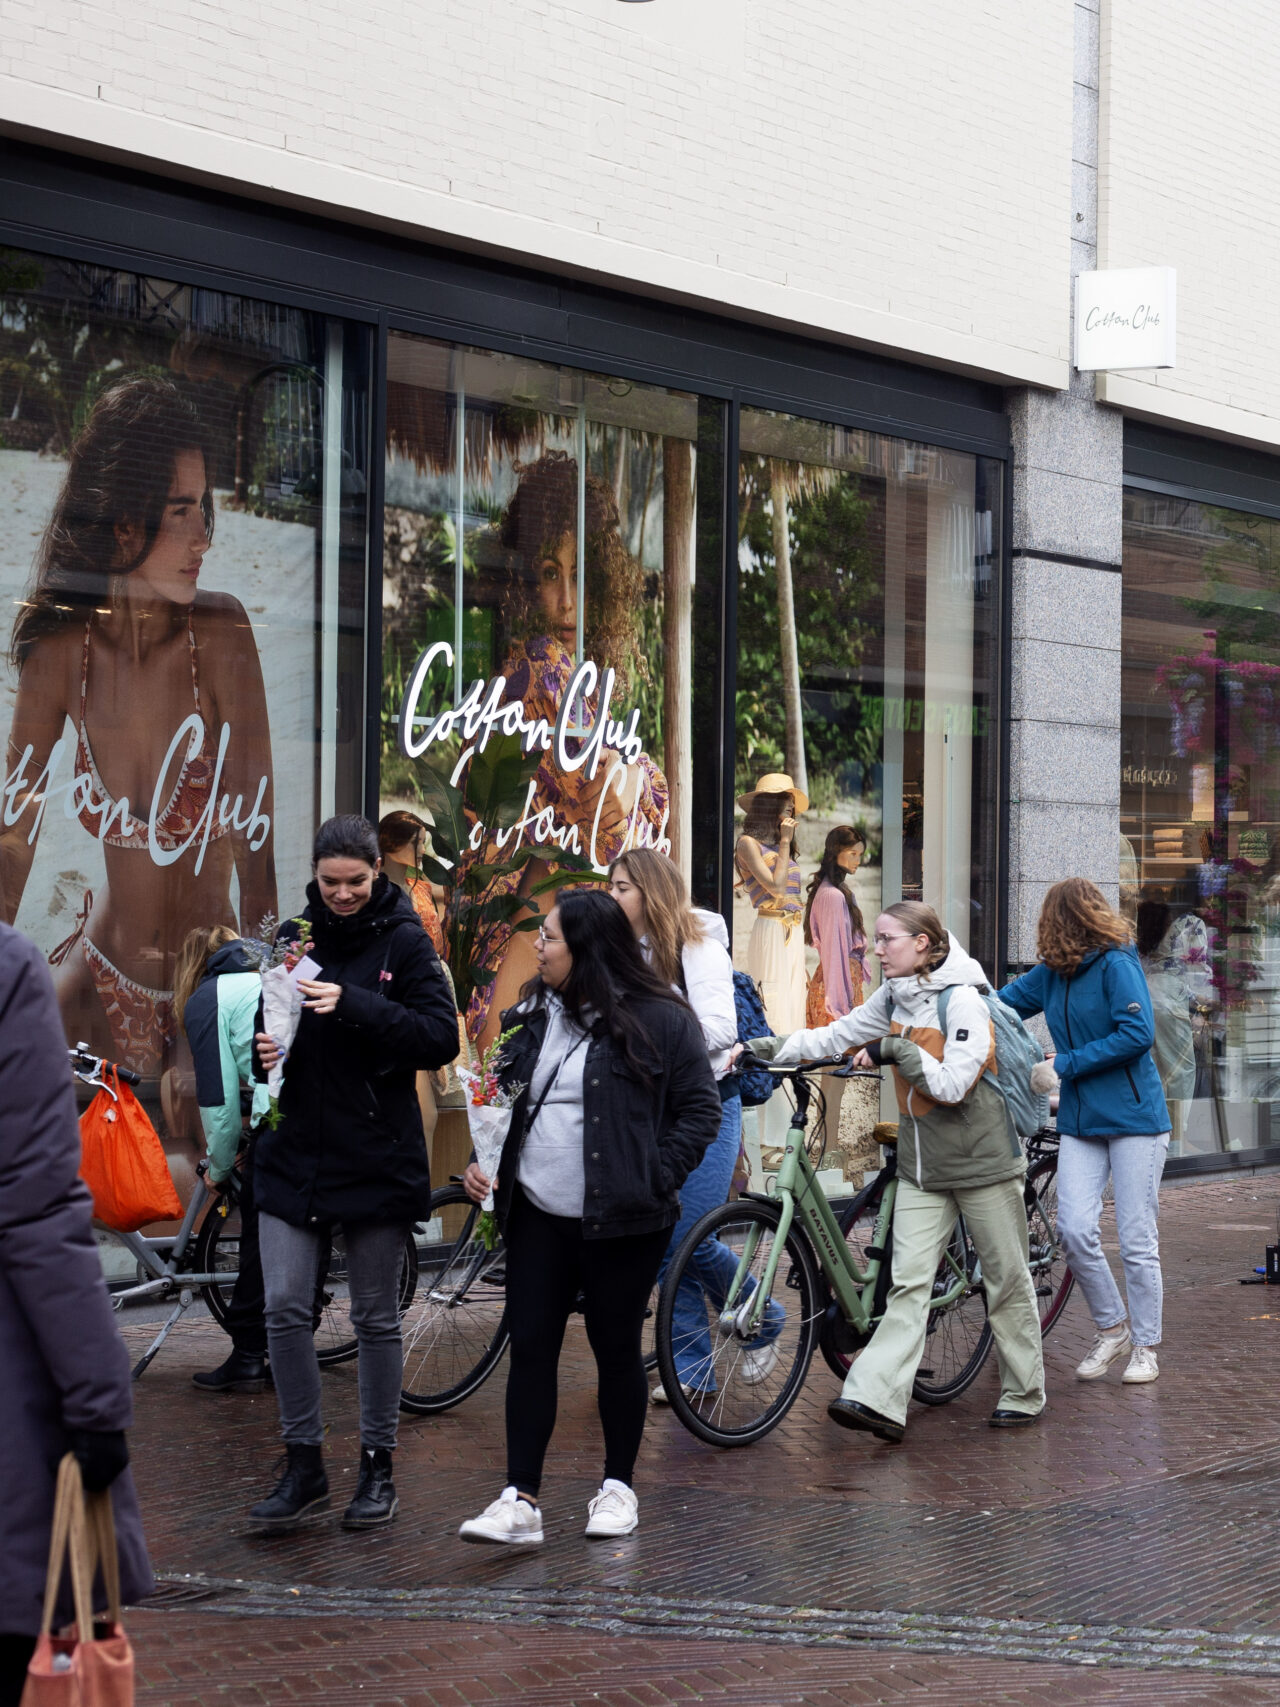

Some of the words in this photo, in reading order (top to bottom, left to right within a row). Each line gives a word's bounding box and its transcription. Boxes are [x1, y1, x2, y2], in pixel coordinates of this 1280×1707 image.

[1086, 306, 1129, 331] Cotton
[1132, 304, 1160, 330] Club
[402, 641, 552, 758] Cotton
[556, 660, 643, 780] Club
[0, 743, 134, 846] tton
[149, 713, 270, 876] Club
[590, 760, 672, 876] Club
[809, 1208, 839, 1266] BATAVUS
